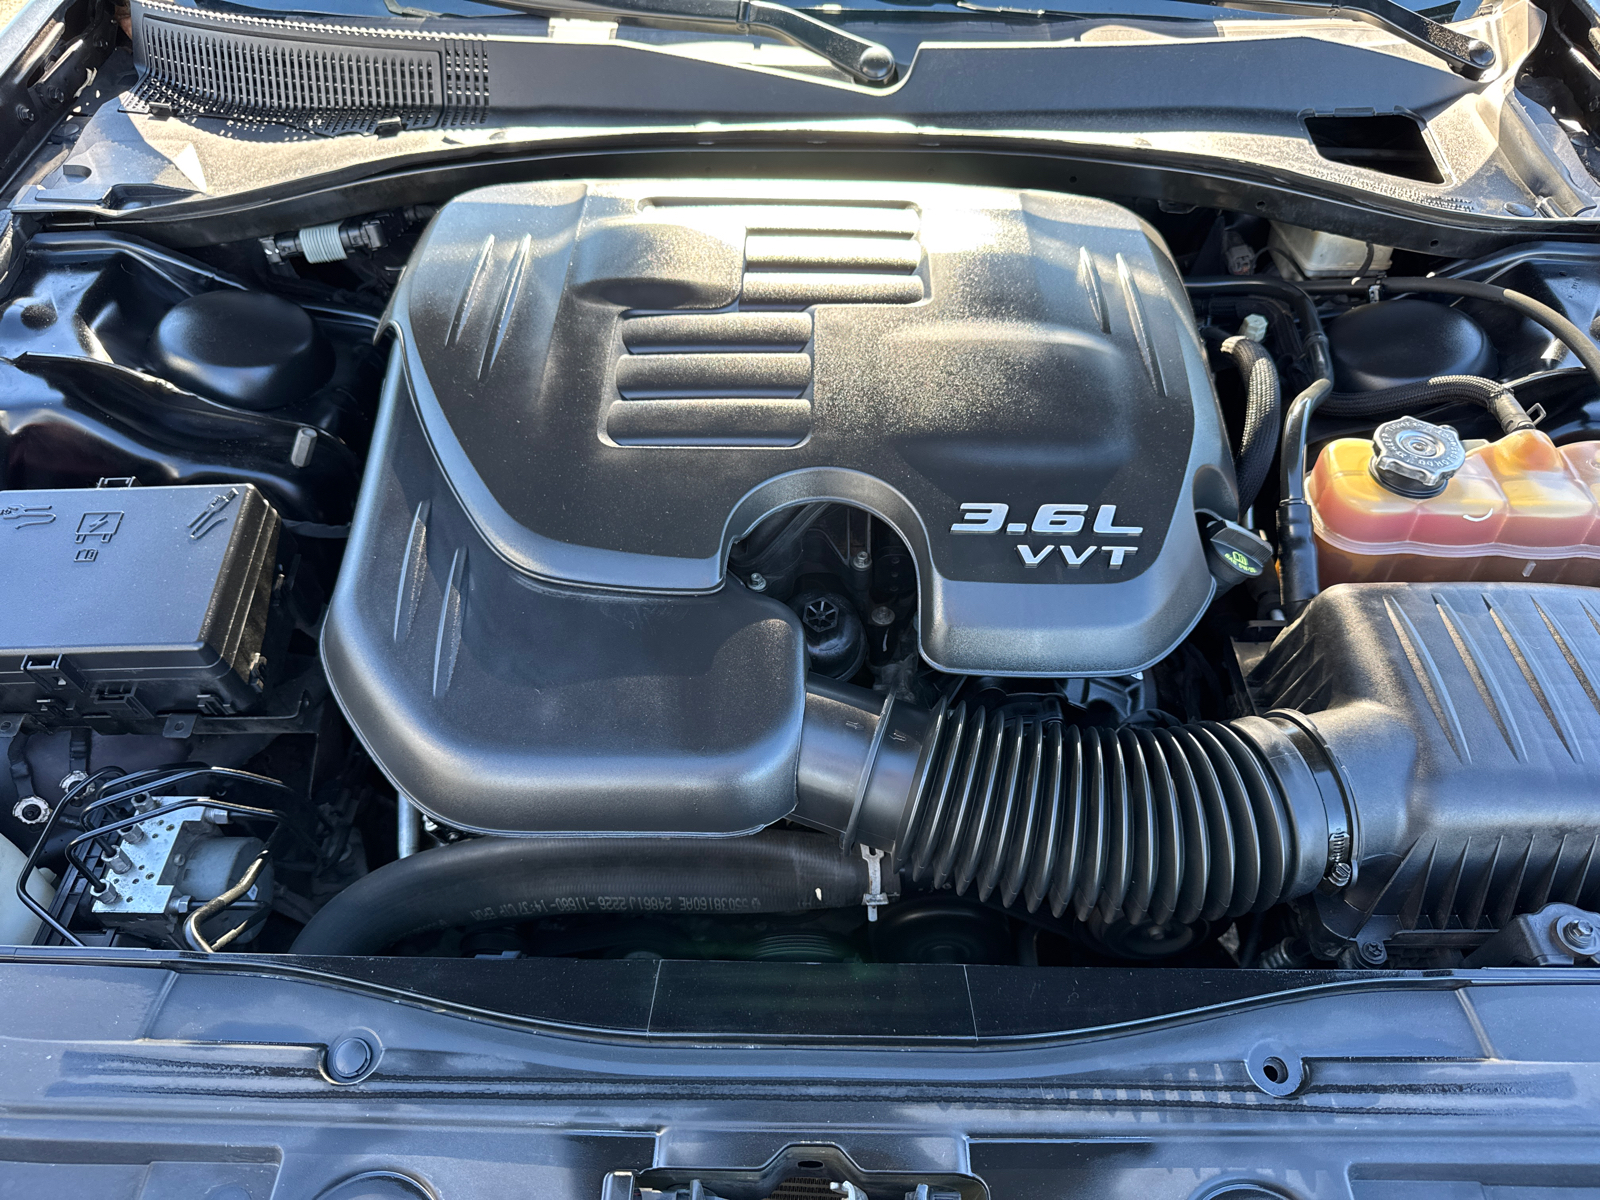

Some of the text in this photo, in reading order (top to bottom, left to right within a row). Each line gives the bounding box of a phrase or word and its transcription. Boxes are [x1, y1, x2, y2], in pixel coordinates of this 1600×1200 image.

[950, 502, 1144, 536] 3.6L
[1016, 544, 1139, 569] VVT
[679, 896, 749, 912] 55038160AE
